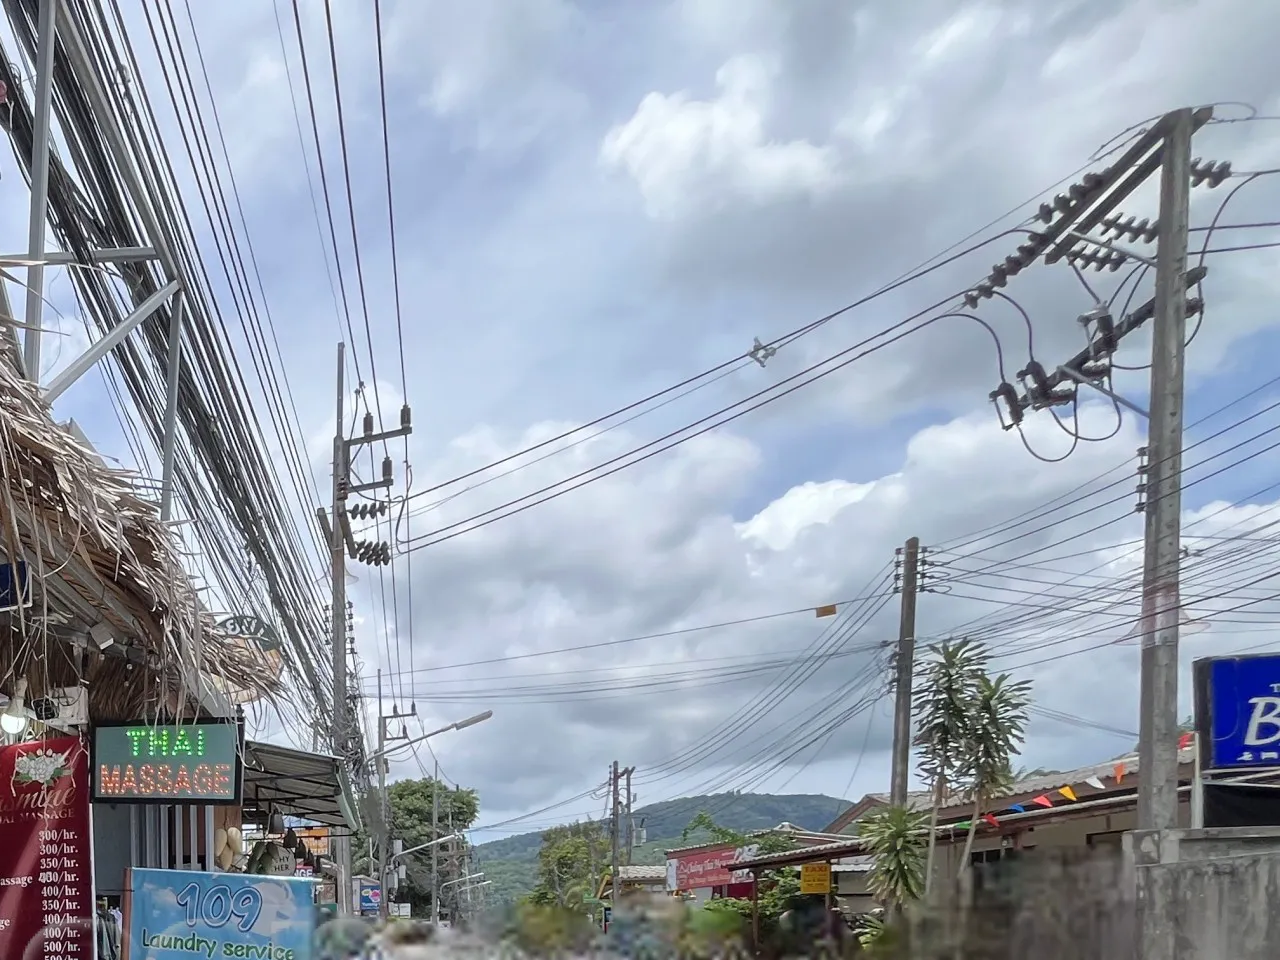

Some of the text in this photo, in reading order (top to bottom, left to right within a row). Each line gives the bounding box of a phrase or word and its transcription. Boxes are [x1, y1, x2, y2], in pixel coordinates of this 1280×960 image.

[126, 728, 204, 757] THAI
[101, 764, 230, 795] MASSAGE
[38, 829, 78, 842] 300/hr.
[39, 843, 78, 856] 300/hr.
[40, 857, 79, 870] 350/hr.
[41, 885, 80, 899] 400/hr.
[42, 899, 80, 912] 350/hr.
[176, 882, 262, 932] 109
[43, 913, 80, 926] 400/hr.
[43, 927, 80, 940] 400/hr.
[43, 941, 81, 954] 500/hr.
[142, 928, 217, 959] Laundry
